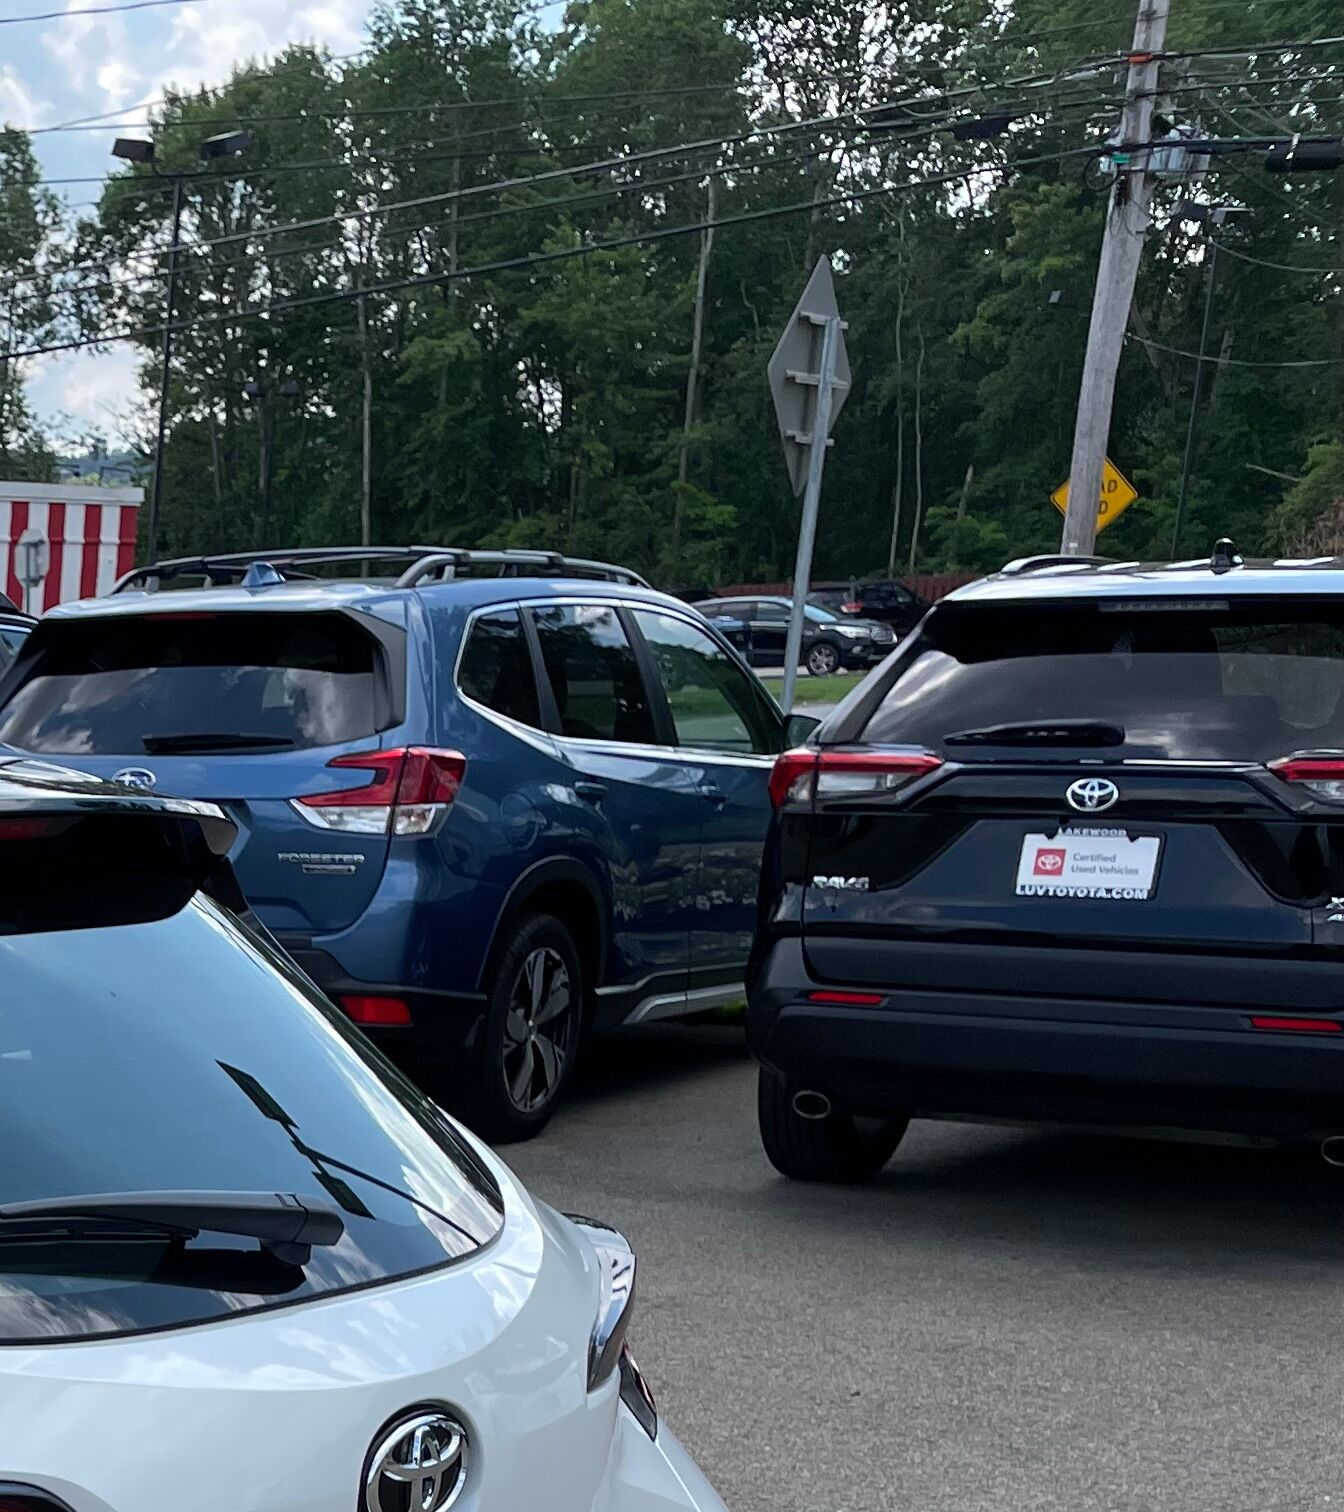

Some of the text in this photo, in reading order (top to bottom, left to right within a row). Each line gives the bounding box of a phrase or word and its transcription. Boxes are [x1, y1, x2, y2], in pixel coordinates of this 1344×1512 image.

[1073, 852, 1117, 863] Certified
[1071, 866, 1139, 876] Used Vehicles
[1015, 885, 1149, 900] LUVTOYOTA.COM
